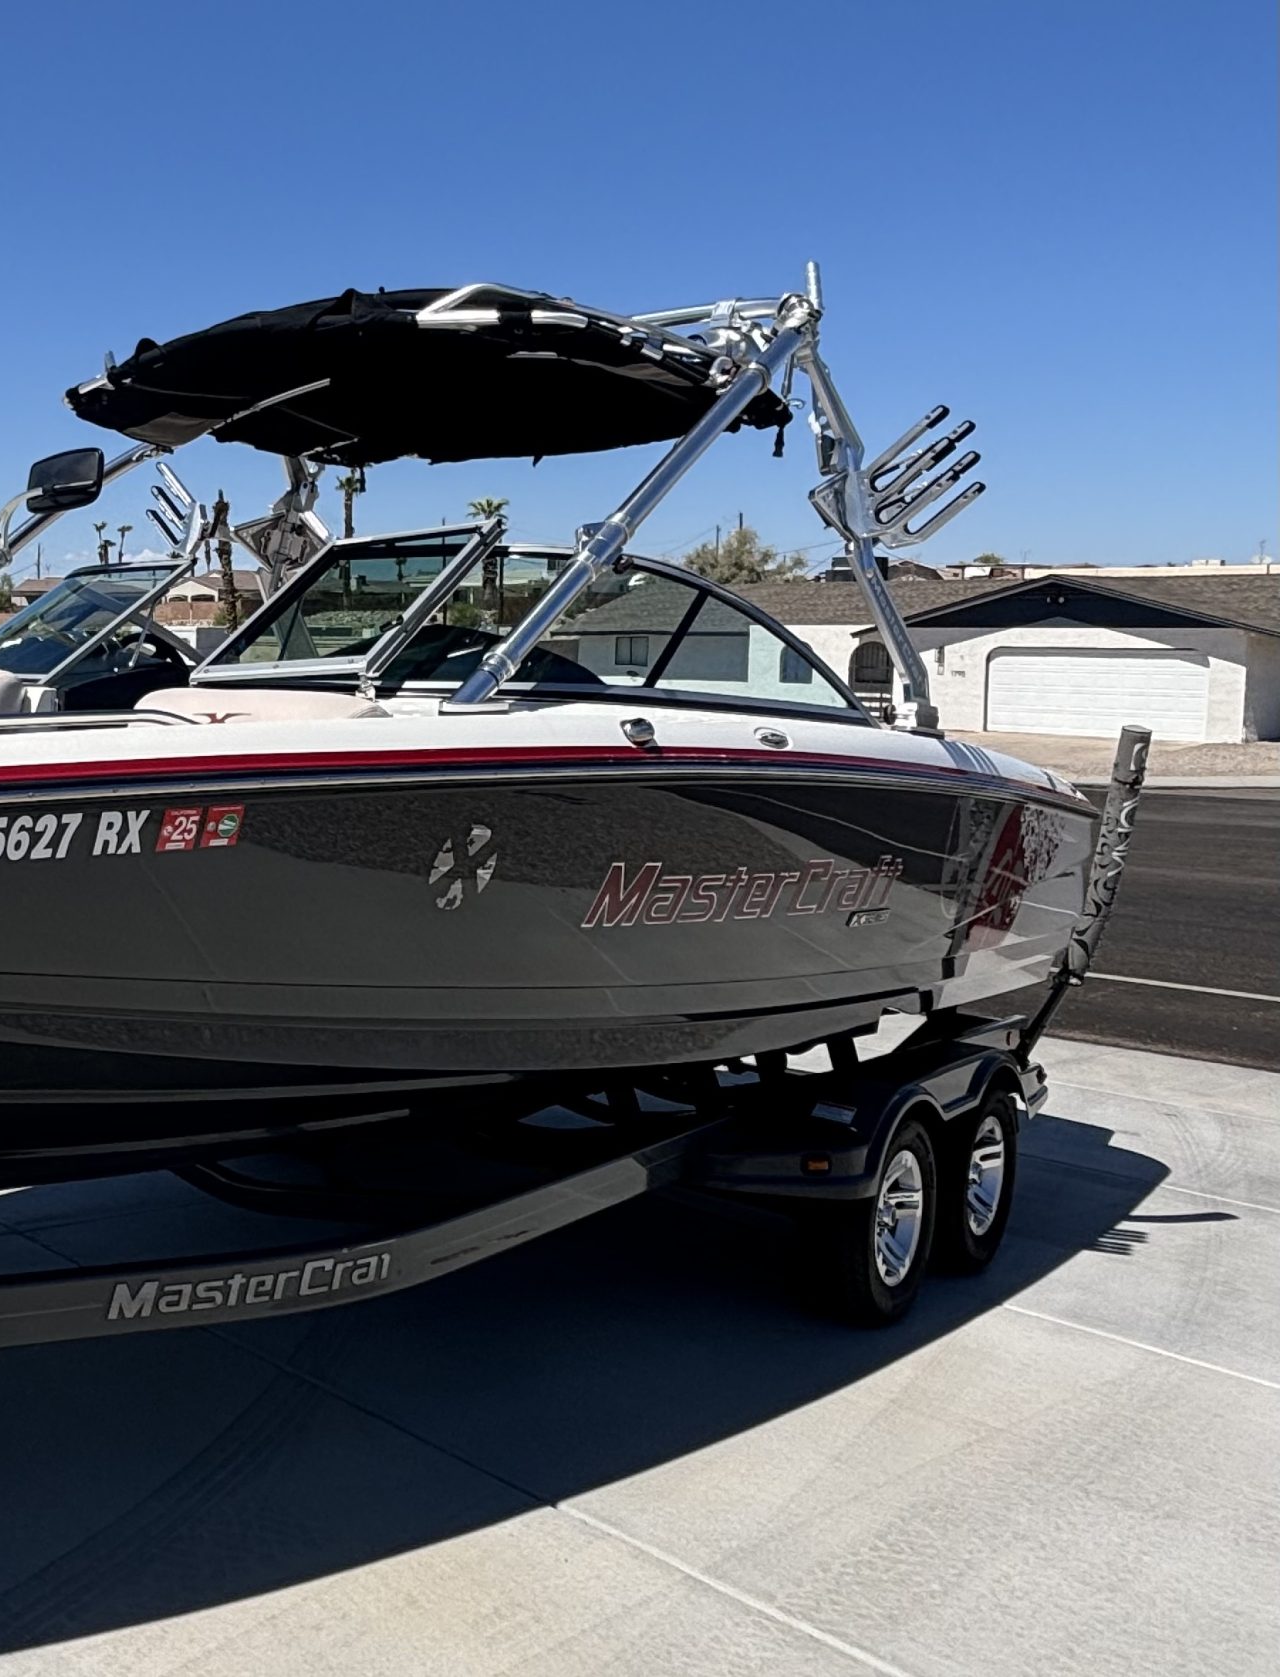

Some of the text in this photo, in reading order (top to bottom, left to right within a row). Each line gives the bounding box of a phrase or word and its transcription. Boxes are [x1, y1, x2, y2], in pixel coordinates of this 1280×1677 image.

[92, 809, 151, 856] RX
[170, 815, 200, 841] 25
[580, 854, 904, 928] MasterCraft
